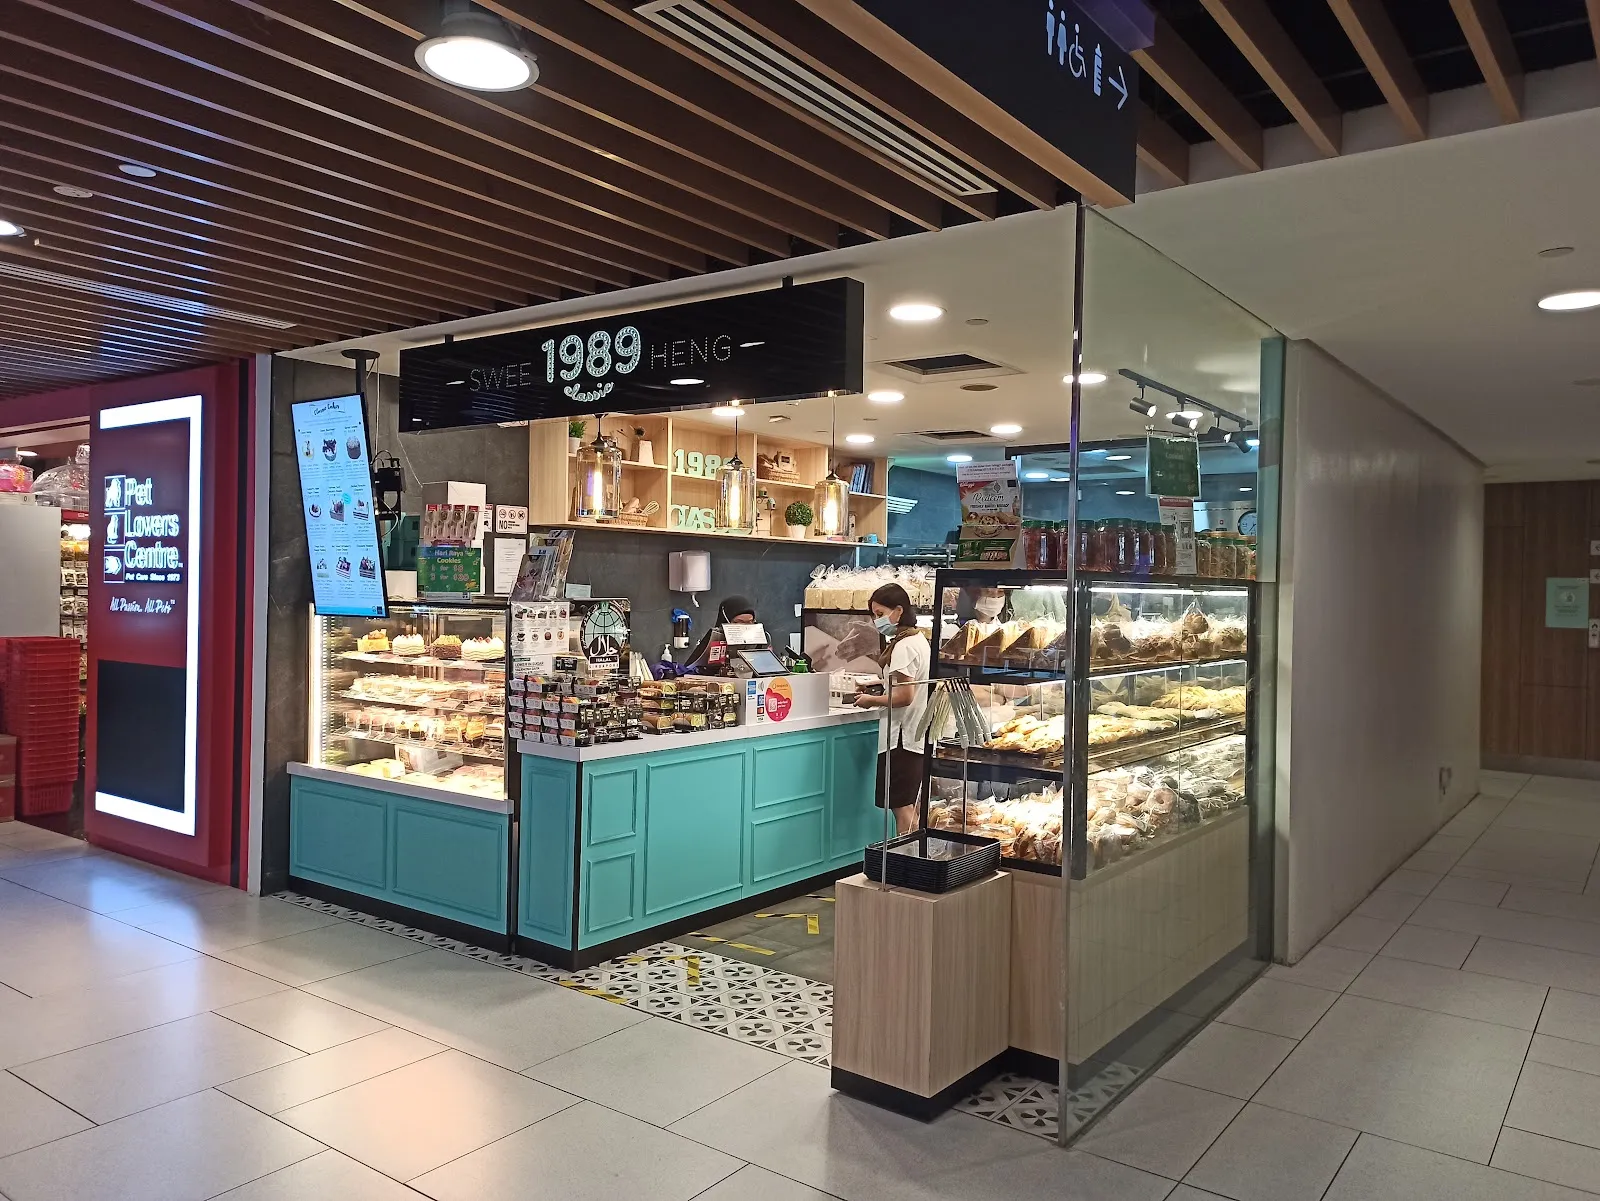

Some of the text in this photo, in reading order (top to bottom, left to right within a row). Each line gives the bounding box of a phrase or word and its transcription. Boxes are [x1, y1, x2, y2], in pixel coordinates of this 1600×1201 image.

[469, 326, 732, 392] SWEE 1989 HENG
[563, 381, 615, 402] classic
[673, 449, 732, 480] 198
[125, 477, 153, 506] Pet
[972, 492, 1004, 504] Redeem
[125, 509, 180, 538] Lovers
[499, 520, 508, 530] NO
[448, 550, 464, 558] Raya
[590, 635, 619, 657] حلال
